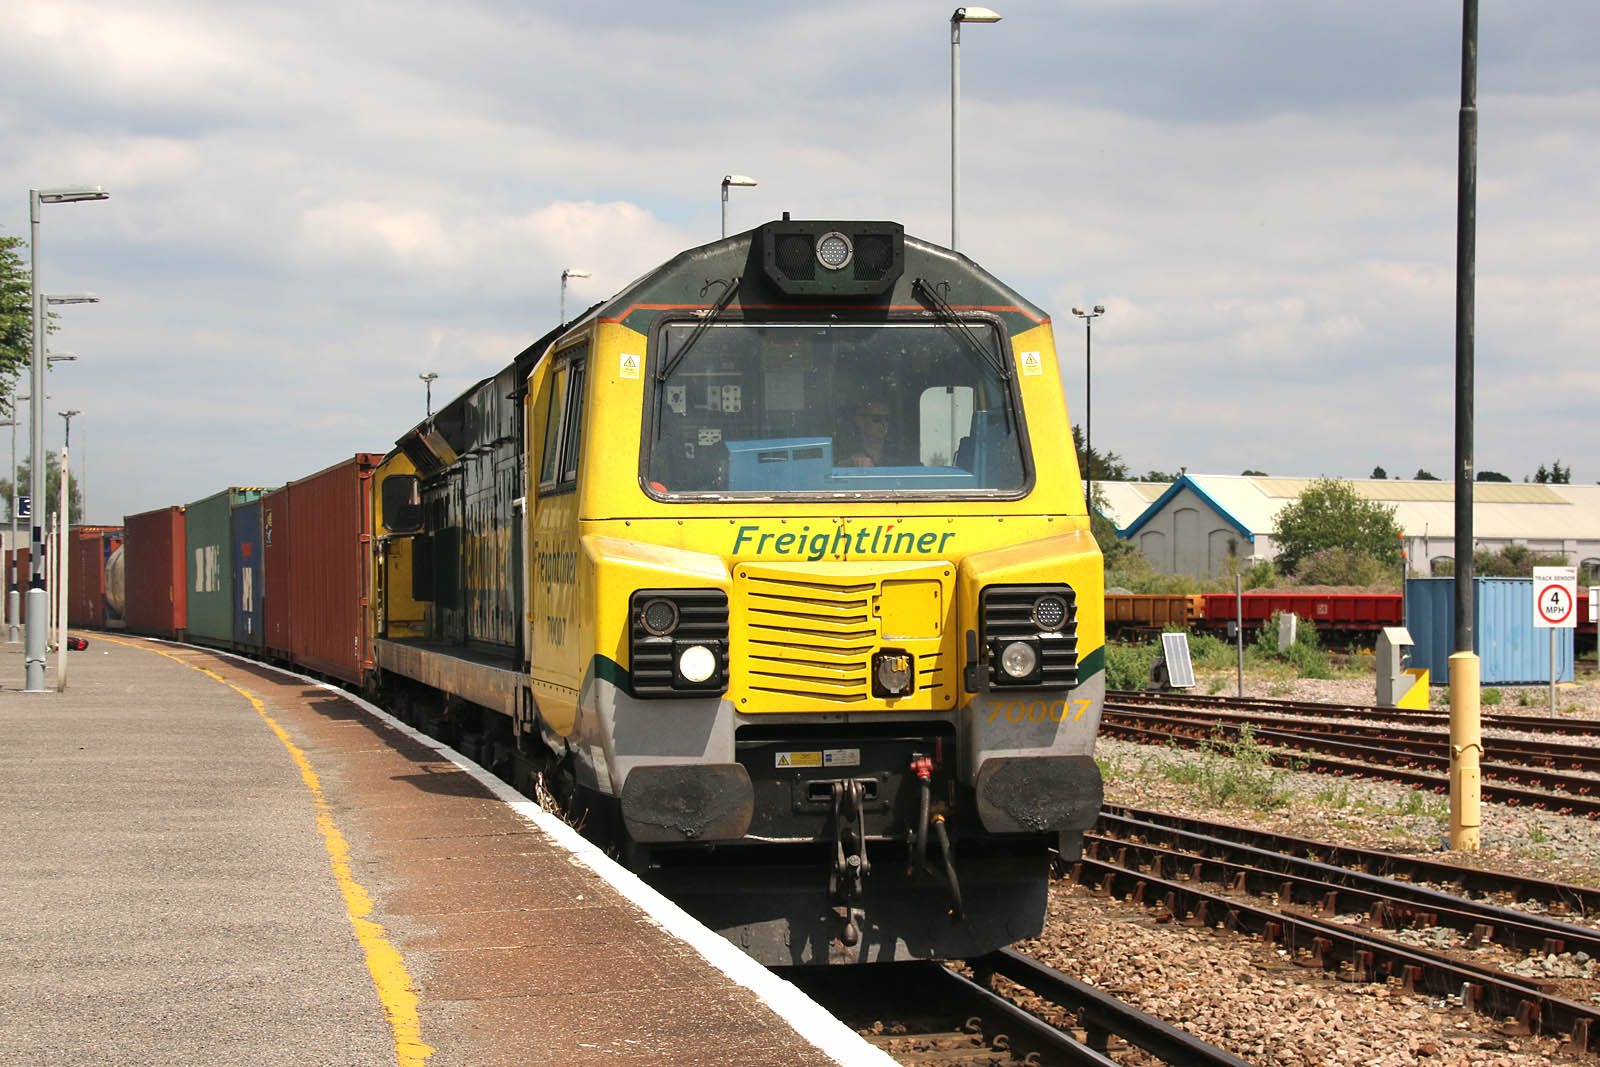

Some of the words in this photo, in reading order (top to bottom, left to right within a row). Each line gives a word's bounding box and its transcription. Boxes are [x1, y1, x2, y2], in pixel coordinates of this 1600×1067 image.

[732, 525, 955, 561] Freightliner
[1550, 591, 1560, 605] 4
[1546, 606, 1564, 614] MPH
[986, 699, 1092, 724] 70007
